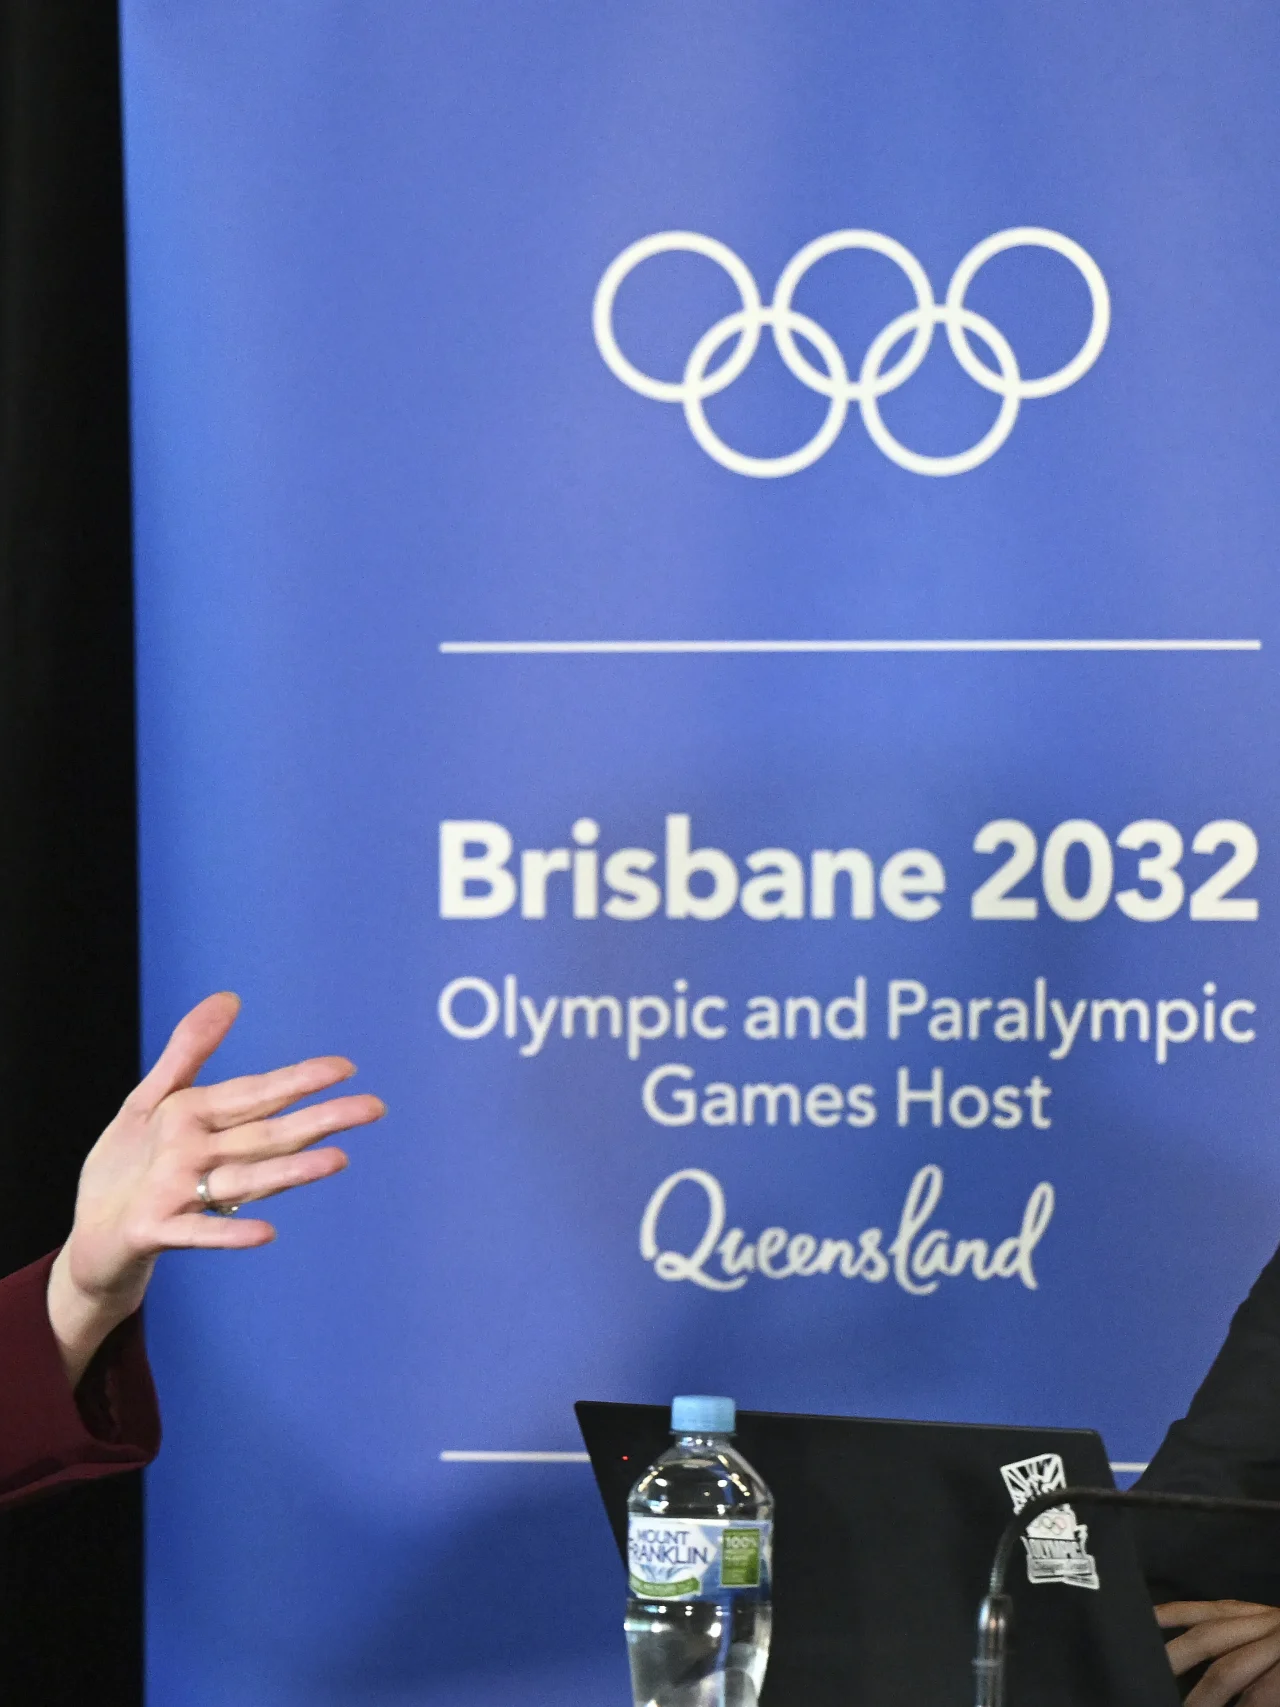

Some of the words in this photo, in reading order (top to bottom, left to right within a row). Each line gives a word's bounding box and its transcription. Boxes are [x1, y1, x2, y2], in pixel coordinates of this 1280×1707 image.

[438, 812, 947, 922] Brisbane
[970, 818, 1260, 923] 2032
[437, 973, 728, 1061] Olympic
[742, 975, 868, 1042] and
[886, 976, 1257, 1065] Paralympic
[641, 1063, 877, 1128] Games
[896, 1066, 1052, 1129] Host
[639, 1164, 1055, 1295] Queensland
[637, 1528, 690, 1546] MOUNT
